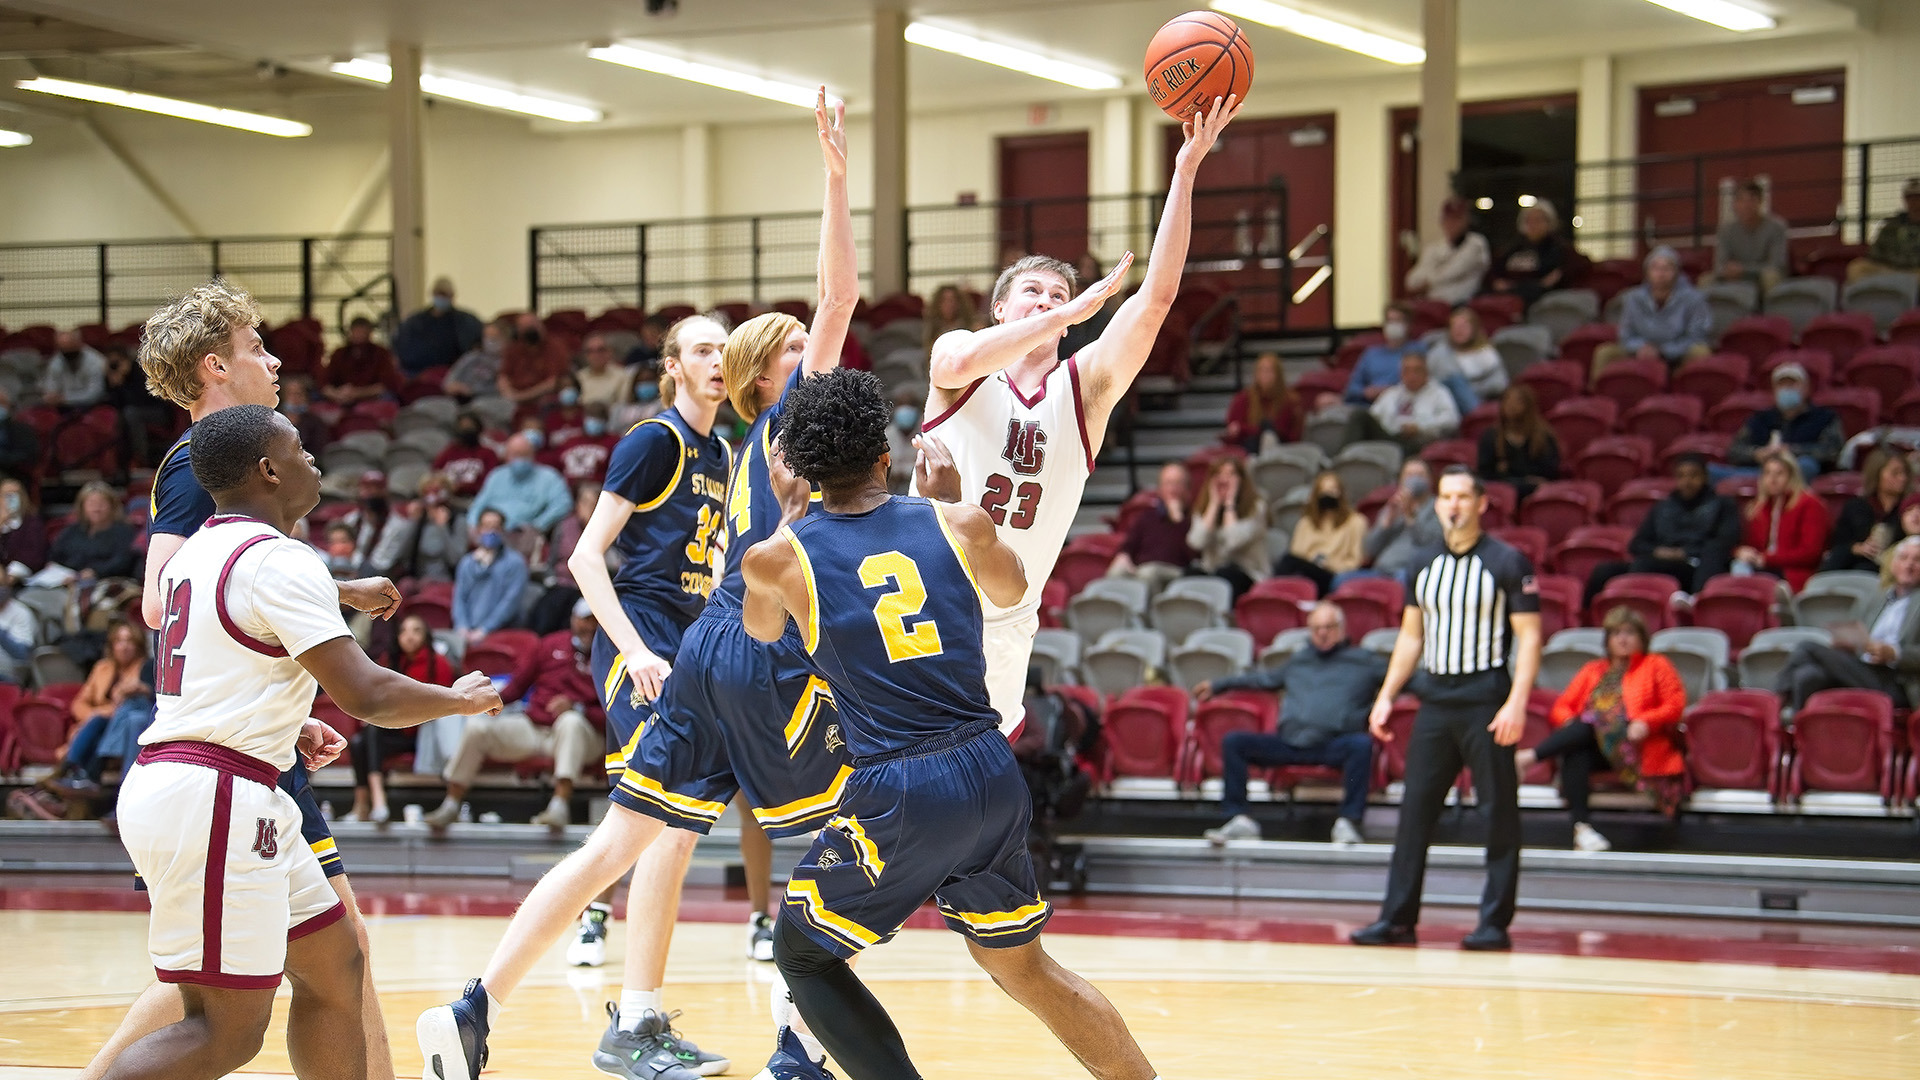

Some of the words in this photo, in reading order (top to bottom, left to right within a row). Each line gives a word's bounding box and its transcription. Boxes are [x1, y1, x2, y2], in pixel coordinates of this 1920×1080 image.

[1161, 57, 1201, 92] ROCK
[979, 472, 1043, 530] 23
[857, 550, 944, 664] 2
